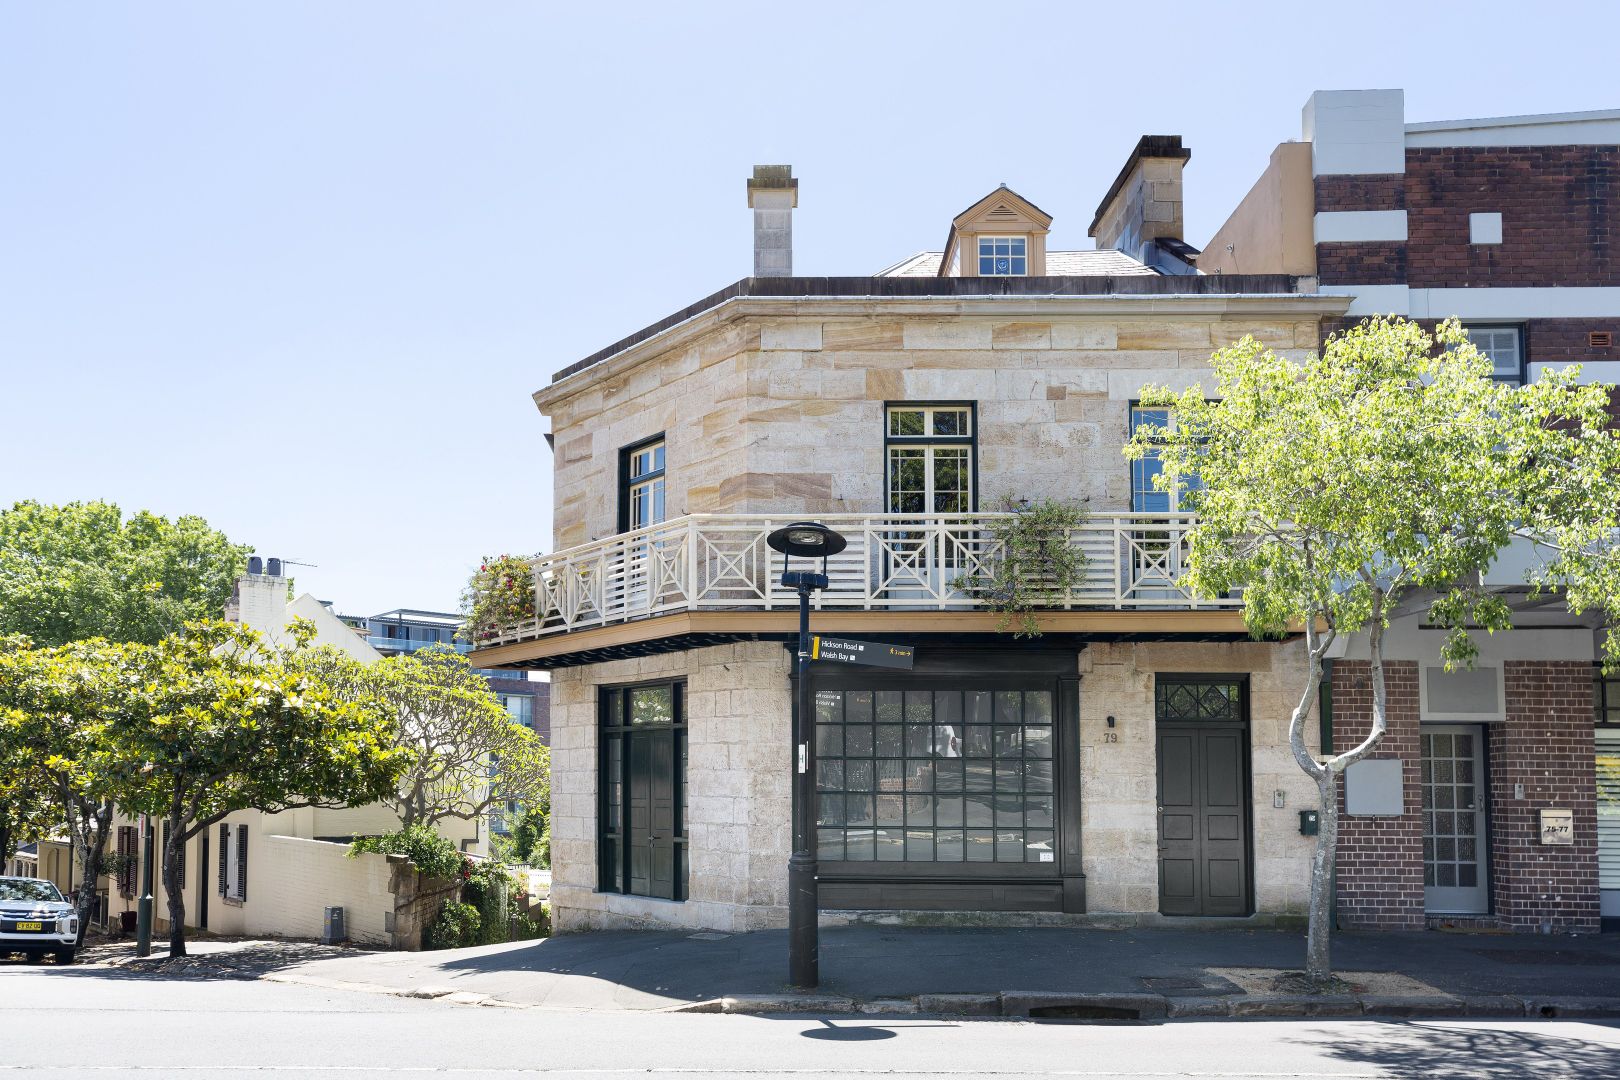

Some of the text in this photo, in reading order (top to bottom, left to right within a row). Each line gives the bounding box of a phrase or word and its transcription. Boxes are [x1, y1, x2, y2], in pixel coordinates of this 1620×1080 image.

[821, 640, 858, 651] Hickson Road
[820, 650, 849, 662] Walsh Bay
[1103, 732, 1118, 744] 79
[1545, 825, 1569, 833] 75-77
